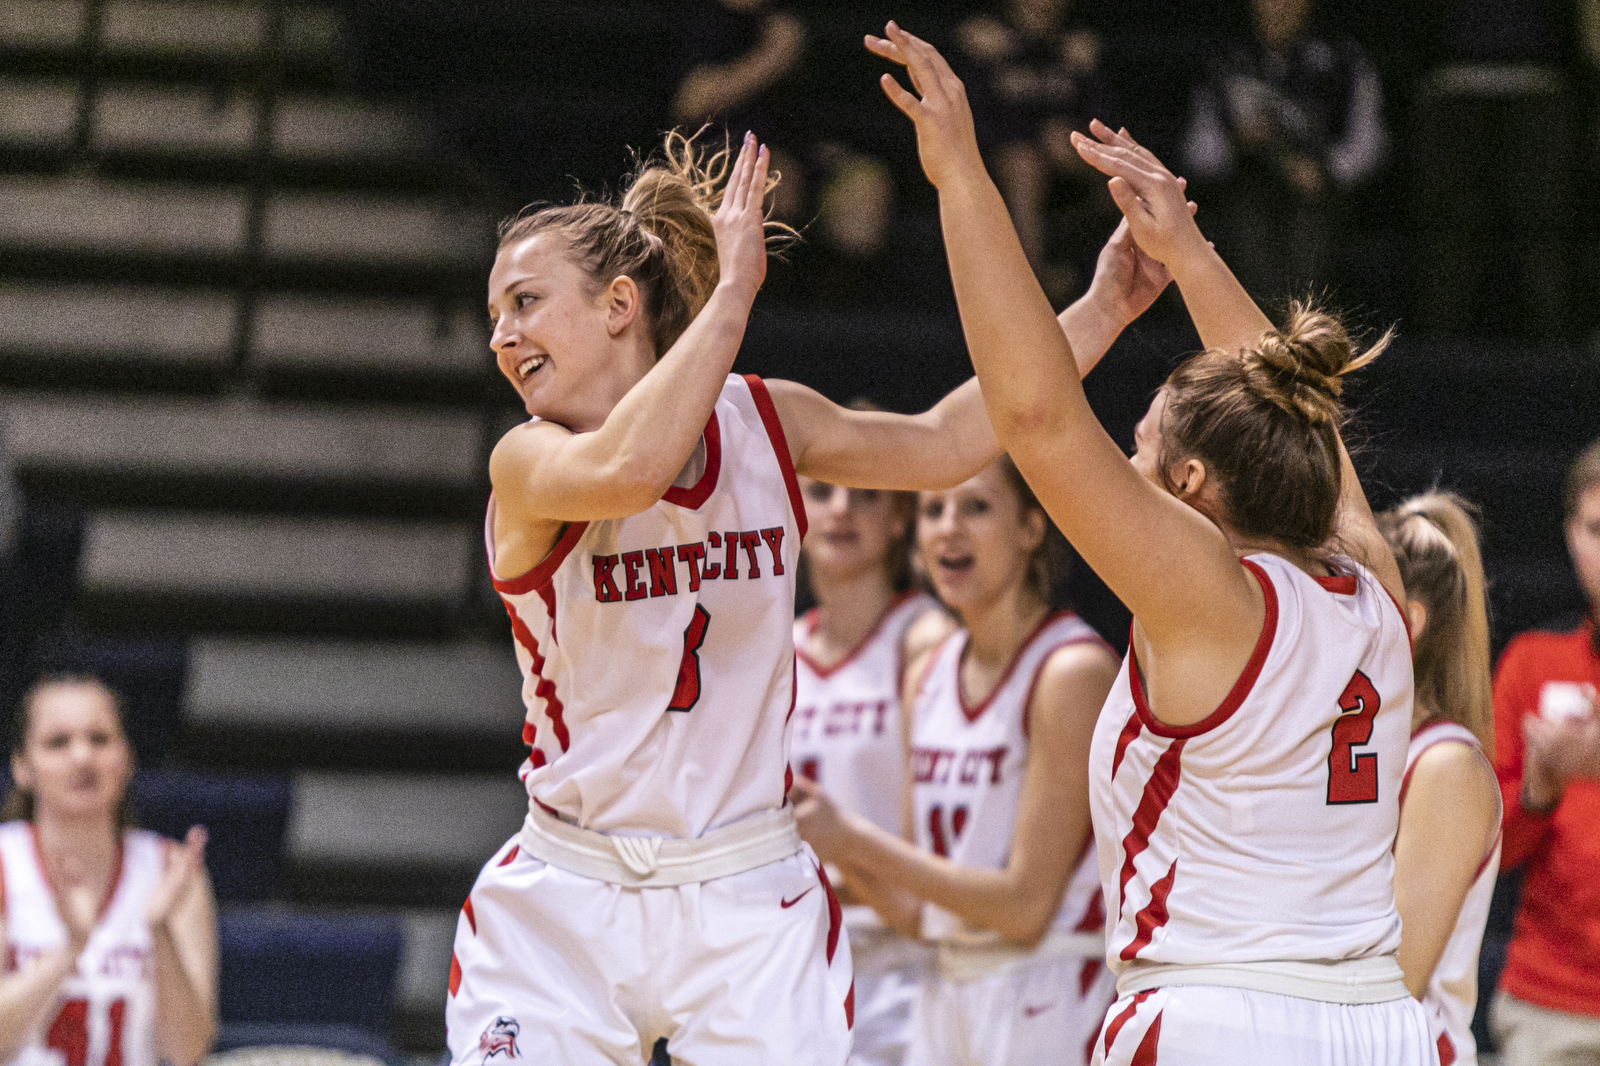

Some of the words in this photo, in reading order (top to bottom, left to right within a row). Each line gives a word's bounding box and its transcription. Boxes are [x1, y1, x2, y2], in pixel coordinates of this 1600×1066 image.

[592, 541, 705, 603] KENT
[701, 526, 785, 580] CITY
[1326, 668, 1381, 805] 2
